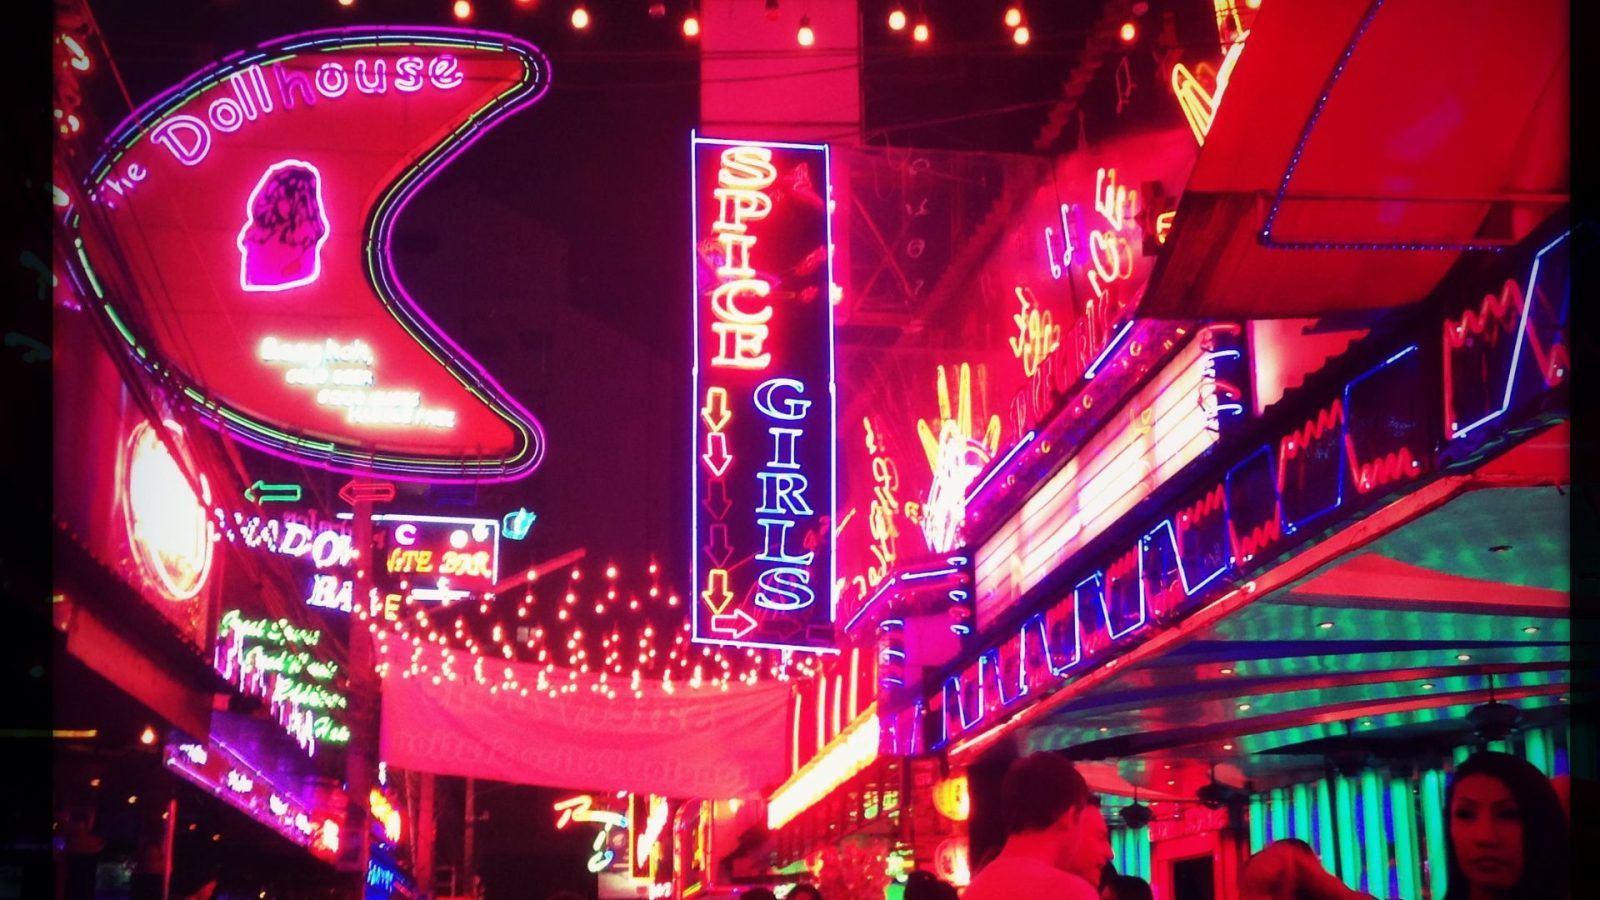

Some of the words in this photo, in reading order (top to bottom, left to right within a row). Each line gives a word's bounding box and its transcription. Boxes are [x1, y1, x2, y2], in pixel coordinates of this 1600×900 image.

[712, 145, 777, 369] SPICE
[306, 574, 353, 613] BA
[753, 378, 815, 610] GIRLS
